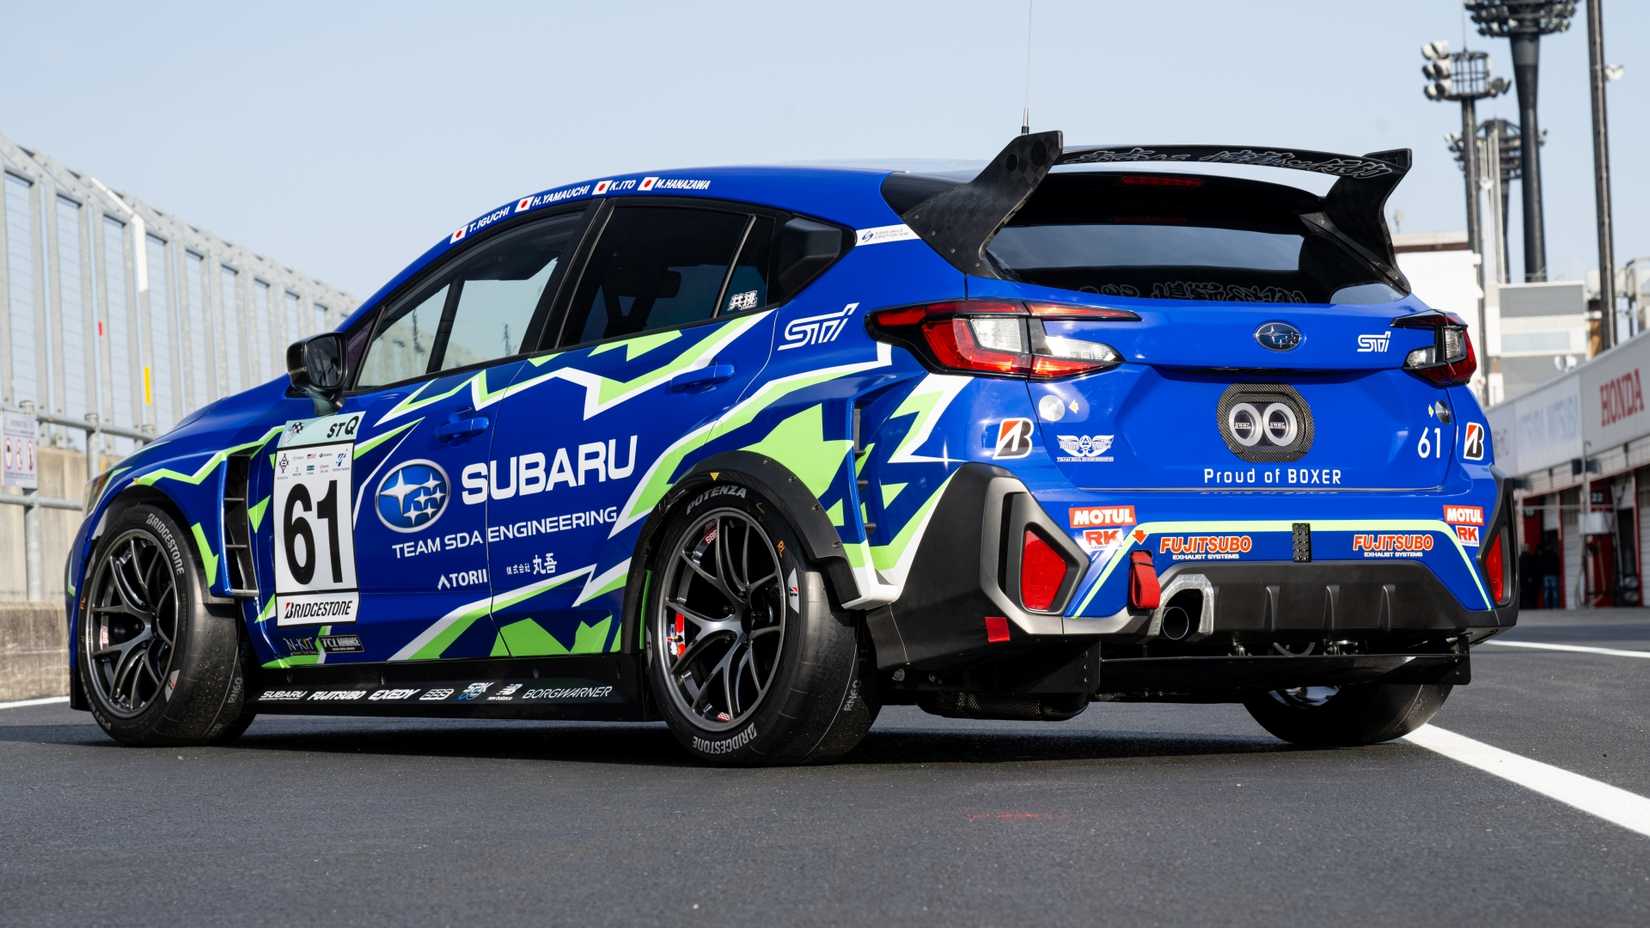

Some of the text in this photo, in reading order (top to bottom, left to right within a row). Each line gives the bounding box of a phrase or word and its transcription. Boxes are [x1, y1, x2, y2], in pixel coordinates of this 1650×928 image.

[609, 180, 637, 192] K.ITO
[654, 179, 711, 191] M.HANAZAWA
[533, 185, 590, 207] H.YAMAUCHI
[468, 207, 510, 233] T.IGUCHI
[1599, 368, 1645, 428] HONDA
[1417, 427, 1441, 459] 61
[461, 435, 638, 505] SUBARU
[1204, 468, 1342, 485] Proud of BOXER
[686, 485, 747, 515] POTENZA
[1073, 508, 1133, 525] MOTUL
[1446, 508, 1483, 523] MOTUL
[283, 480, 343, 585] 61
[392, 506, 618, 559] TEAM SDA ENGINEERING
[1085, 530, 1119, 545] RK
[1457, 526, 1478, 541] RK
[145, 512, 185, 576] BRIDGESTONE
[1160, 535, 1253, 554] FUJITSUBO
[1352, 534, 1434, 551] FUJITSUBO
[284, 600, 353, 619] BRIDGESTONE
[260, 690, 307, 700] SUBARU
[368, 689, 420, 700] EXEDY
[522, 686, 613, 699] BORGWARNER
[692, 722, 757, 754] BRIDGESTONE
